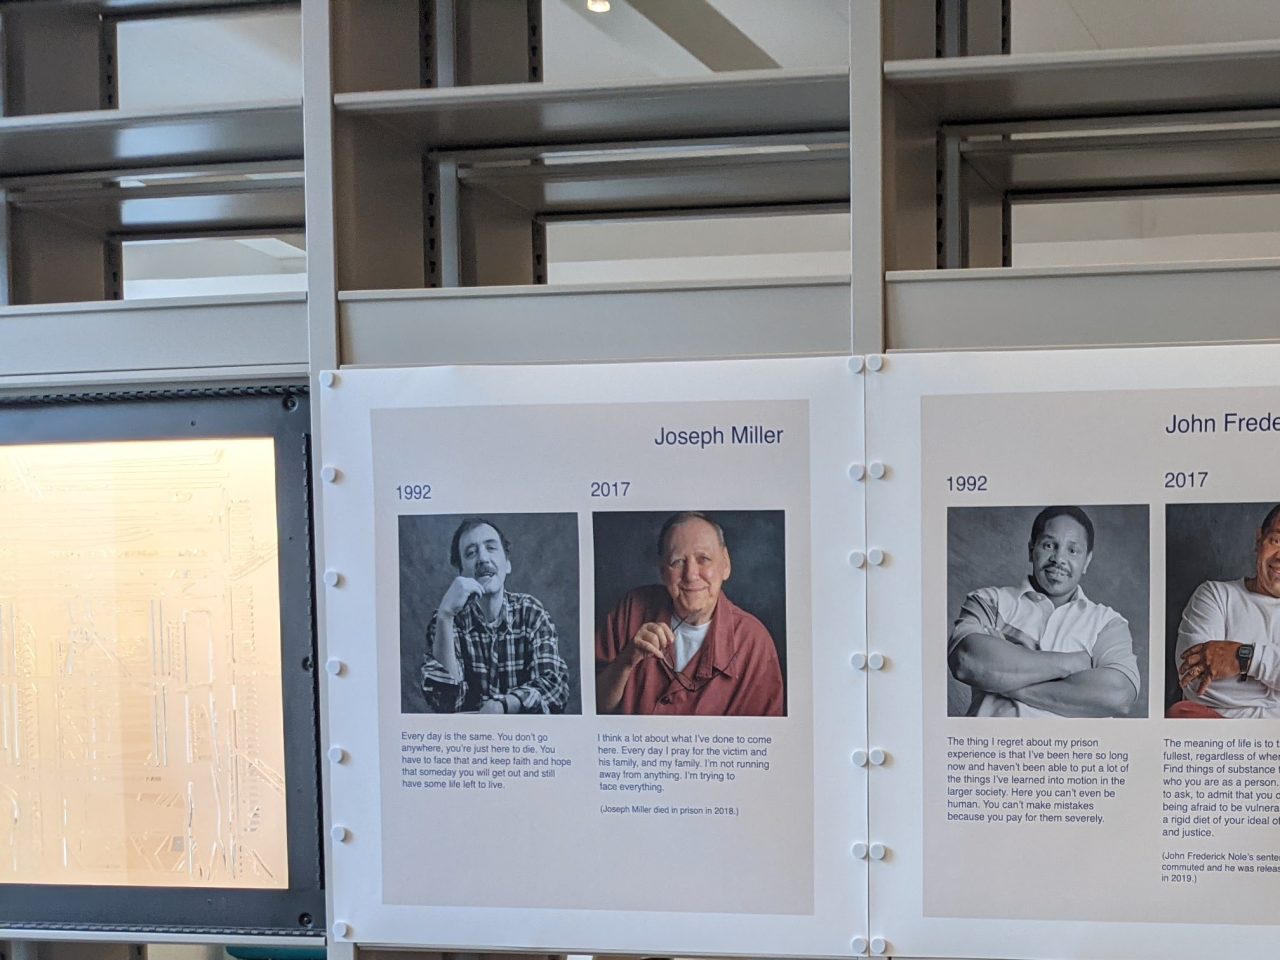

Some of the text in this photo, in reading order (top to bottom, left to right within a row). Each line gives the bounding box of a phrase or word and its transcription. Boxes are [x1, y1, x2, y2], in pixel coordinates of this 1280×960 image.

[1165, 413, 1216, 434] John
[654, 425, 784, 450] Joseph Miller
[946, 475, 988, 492] 1992
[1164, 471, 1209, 489] 2017
[396, 484, 432, 501] 1992
[590, 481, 631, 498] 2017
[401, 731, 425, 742] Every
[426, 731, 442, 742] day
[443, 731, 451, 740] is
[453, 731, 467, 740] the
[496, 732, 513, 741] You
[514, 732, 536, 741] don't
[537, 734, 548, 743] go
[602, 733, 622, 742] think
[632, 733, 643, 742] lot
[644, 733, 669, 742] about
[671, 733, 692, 742] what
[694, 733, 710, 742] I've
[712, 734, 734, 743] done
[736, 735, 745, 743] to
[946, 736, 964, 745] The
[966, 736, 988, 747] thing
[996, 737, 1023, 748] regret
[1025, 737, 1051, 746] about
[1054, 739, 1068, 748] my
[1070, 737, 1098, 749] prison
[947, 748, 996, 760] experience
[998, 749, 1006, 758] is
[1008, 749, 1025, 758] that
[1028, 749, 1044, 758] I've
[1046, 749, 1069, 759] been
[1072, 750, 1092, 759] here
[1108, 750, 1128, 761] long
[1163, 763, 1183, 773] Find
[1185, 763, 1213, 775] things
[1216, 763, 1225, 773] of
[1227, 764, 1275, 773] substance
[402, 778, 422, 787] have
[448, 779, 461, 788] life
[462, 779, 476, 788] left
[477, 780, 486, 788] to
[488, 779, 505, 788] live.
[599, 803, 738, 816] (Joseph Miller died in prison in 2018.)
[947, 811, 1104, 824] because you pay for them severely.
[1161, 826, 1214, 838] and justice.
[1161, 850, 1185, 862] (John
[1187, 851, 1225, 860] Frederick
[1227, 851, 1254, 860] Nole's
[1161, 862, 1205, 871] commuted
[1206, 862, 1222, 871] and
[1224, 862, 1235, 872] he
[1161, 872, 1197, 883] in 2019.)
